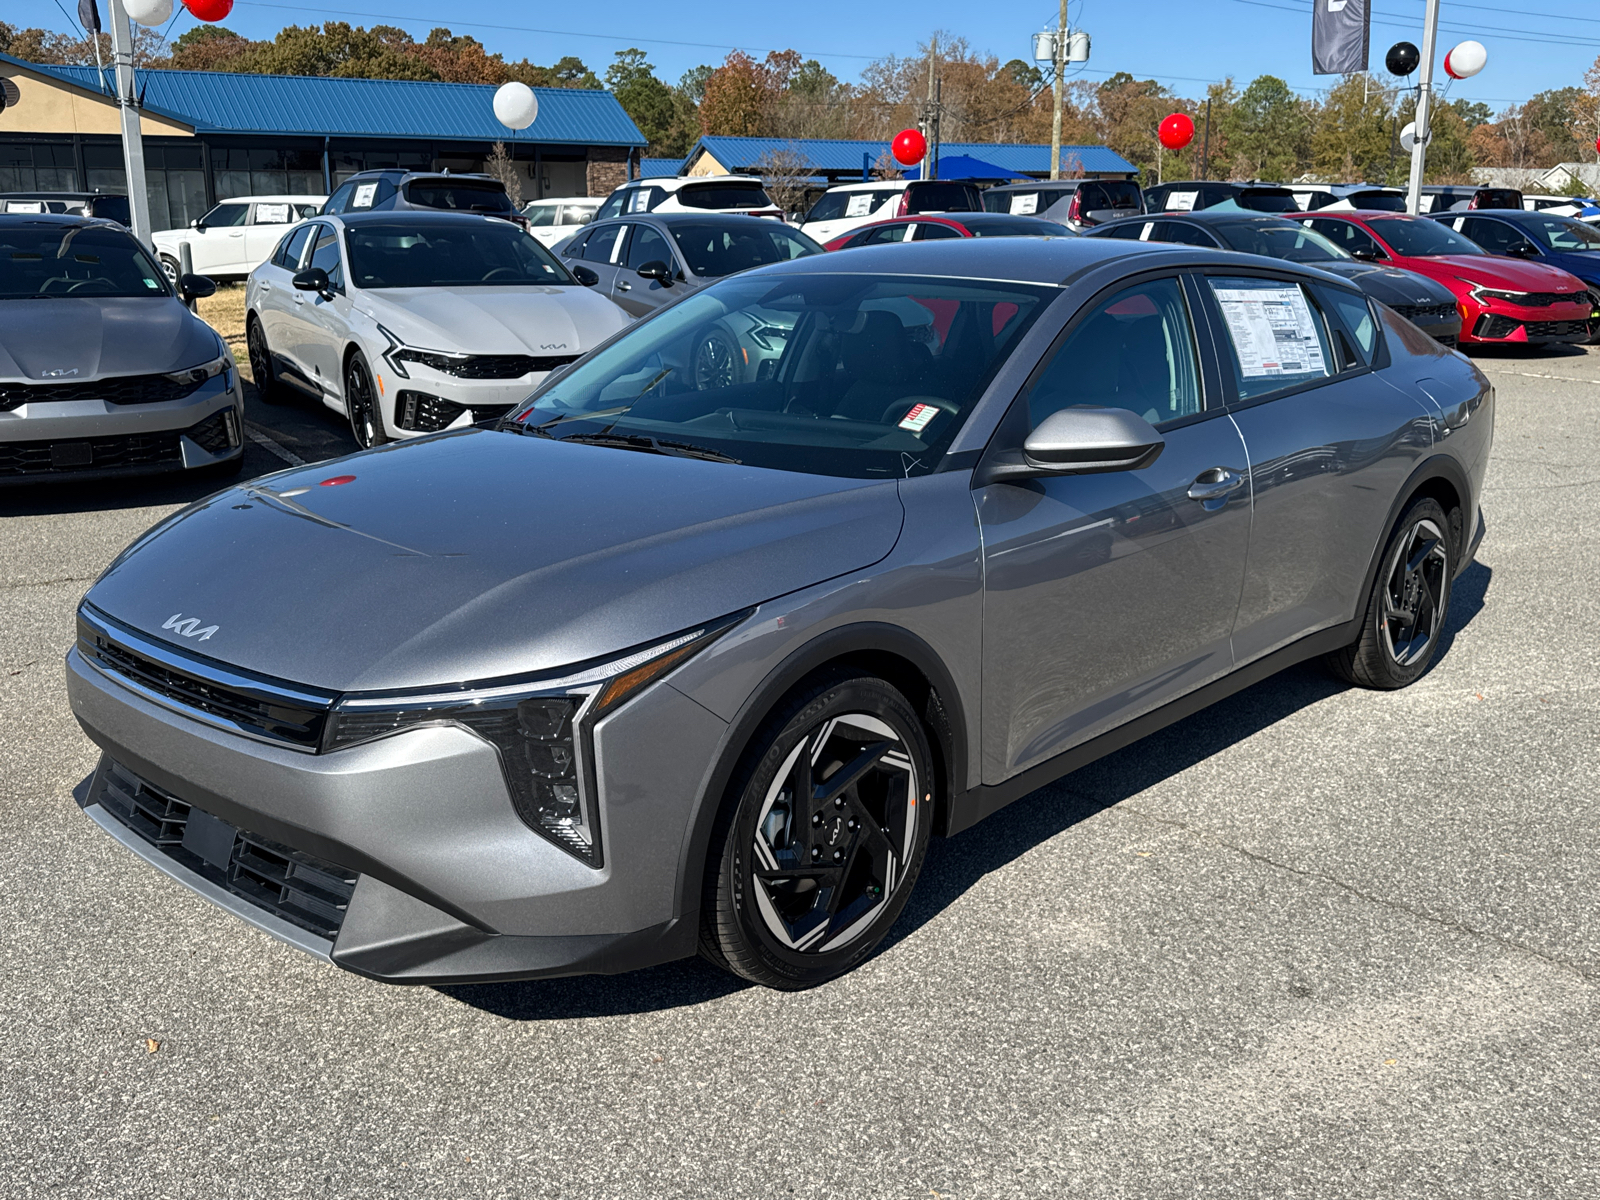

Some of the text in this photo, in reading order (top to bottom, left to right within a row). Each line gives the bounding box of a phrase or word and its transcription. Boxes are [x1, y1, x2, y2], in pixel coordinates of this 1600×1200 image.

[41, 368, 79, 377] KIA
[161, 612, 220, 642] KIA
[743, 745, 781, 820] KUMHO
